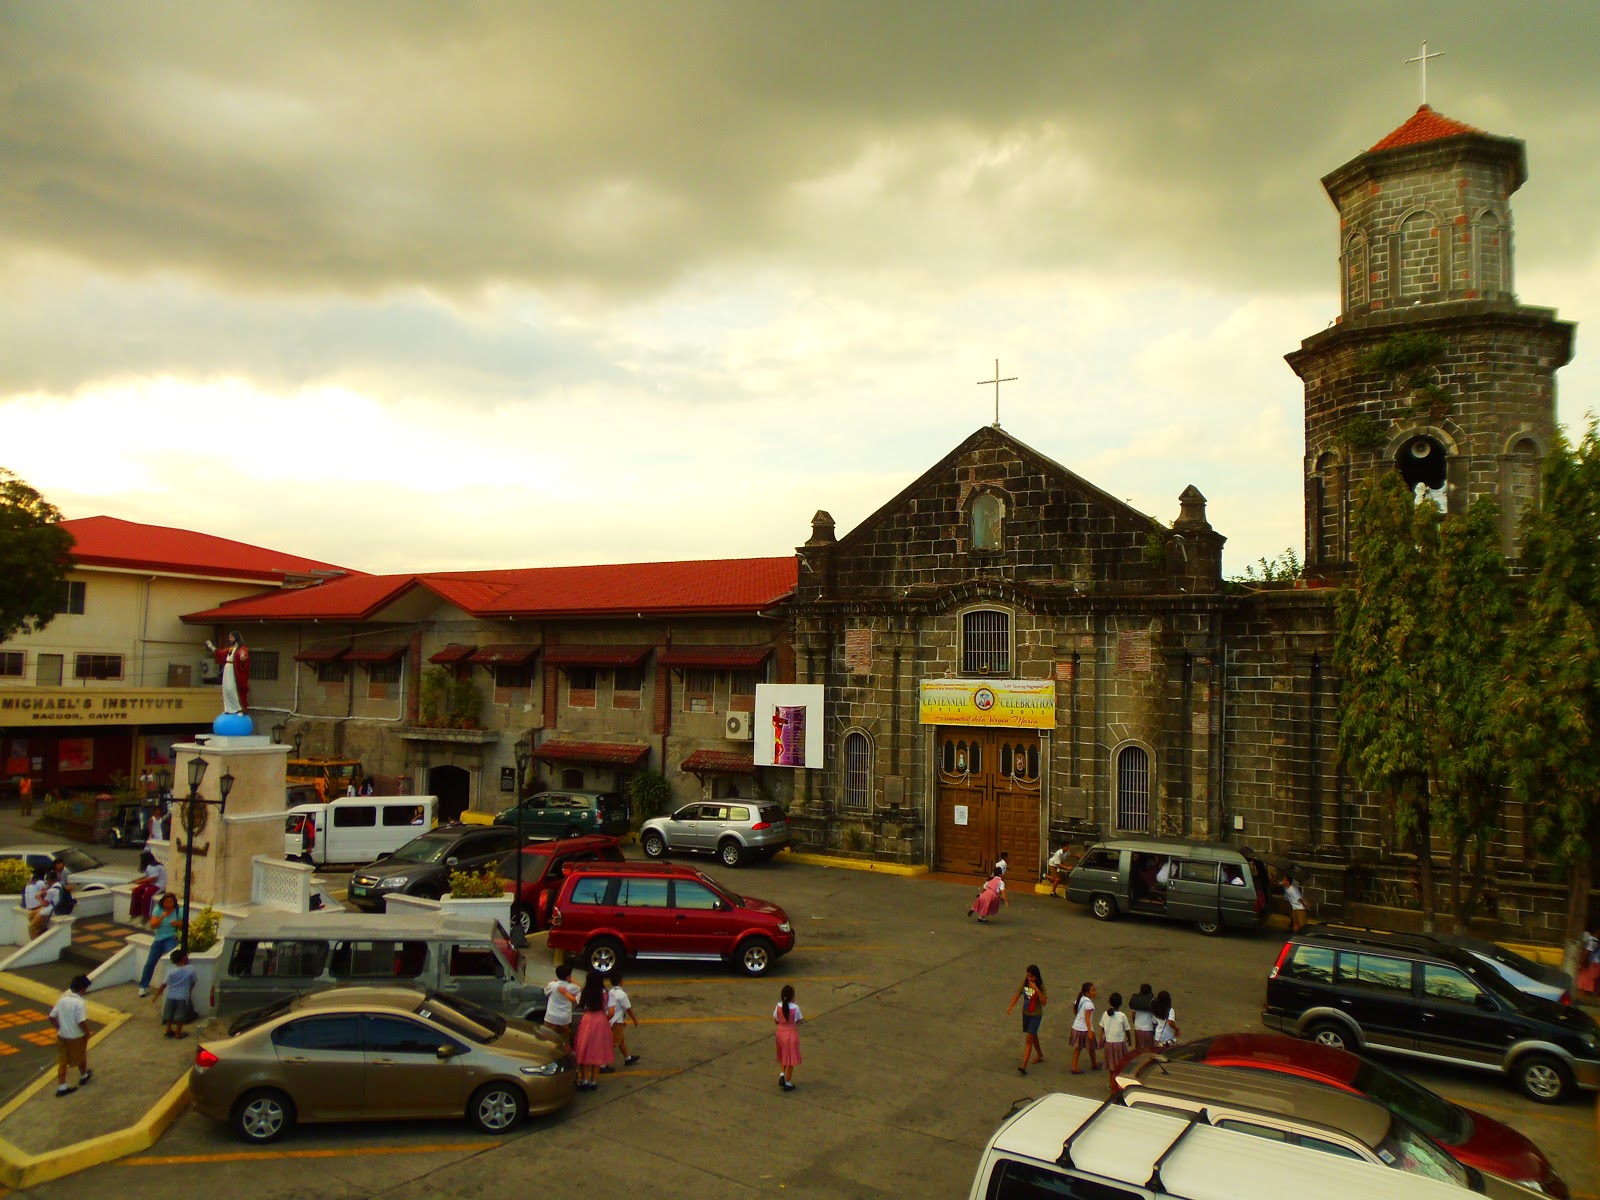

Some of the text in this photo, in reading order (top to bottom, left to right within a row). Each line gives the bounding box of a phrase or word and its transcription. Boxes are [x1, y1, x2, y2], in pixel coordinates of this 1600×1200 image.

[2, 698, 183, 709] MICHAEL'S INSTITUTE
[922, 696, 1054, 709] CENTENNIAL CELEBRATION
